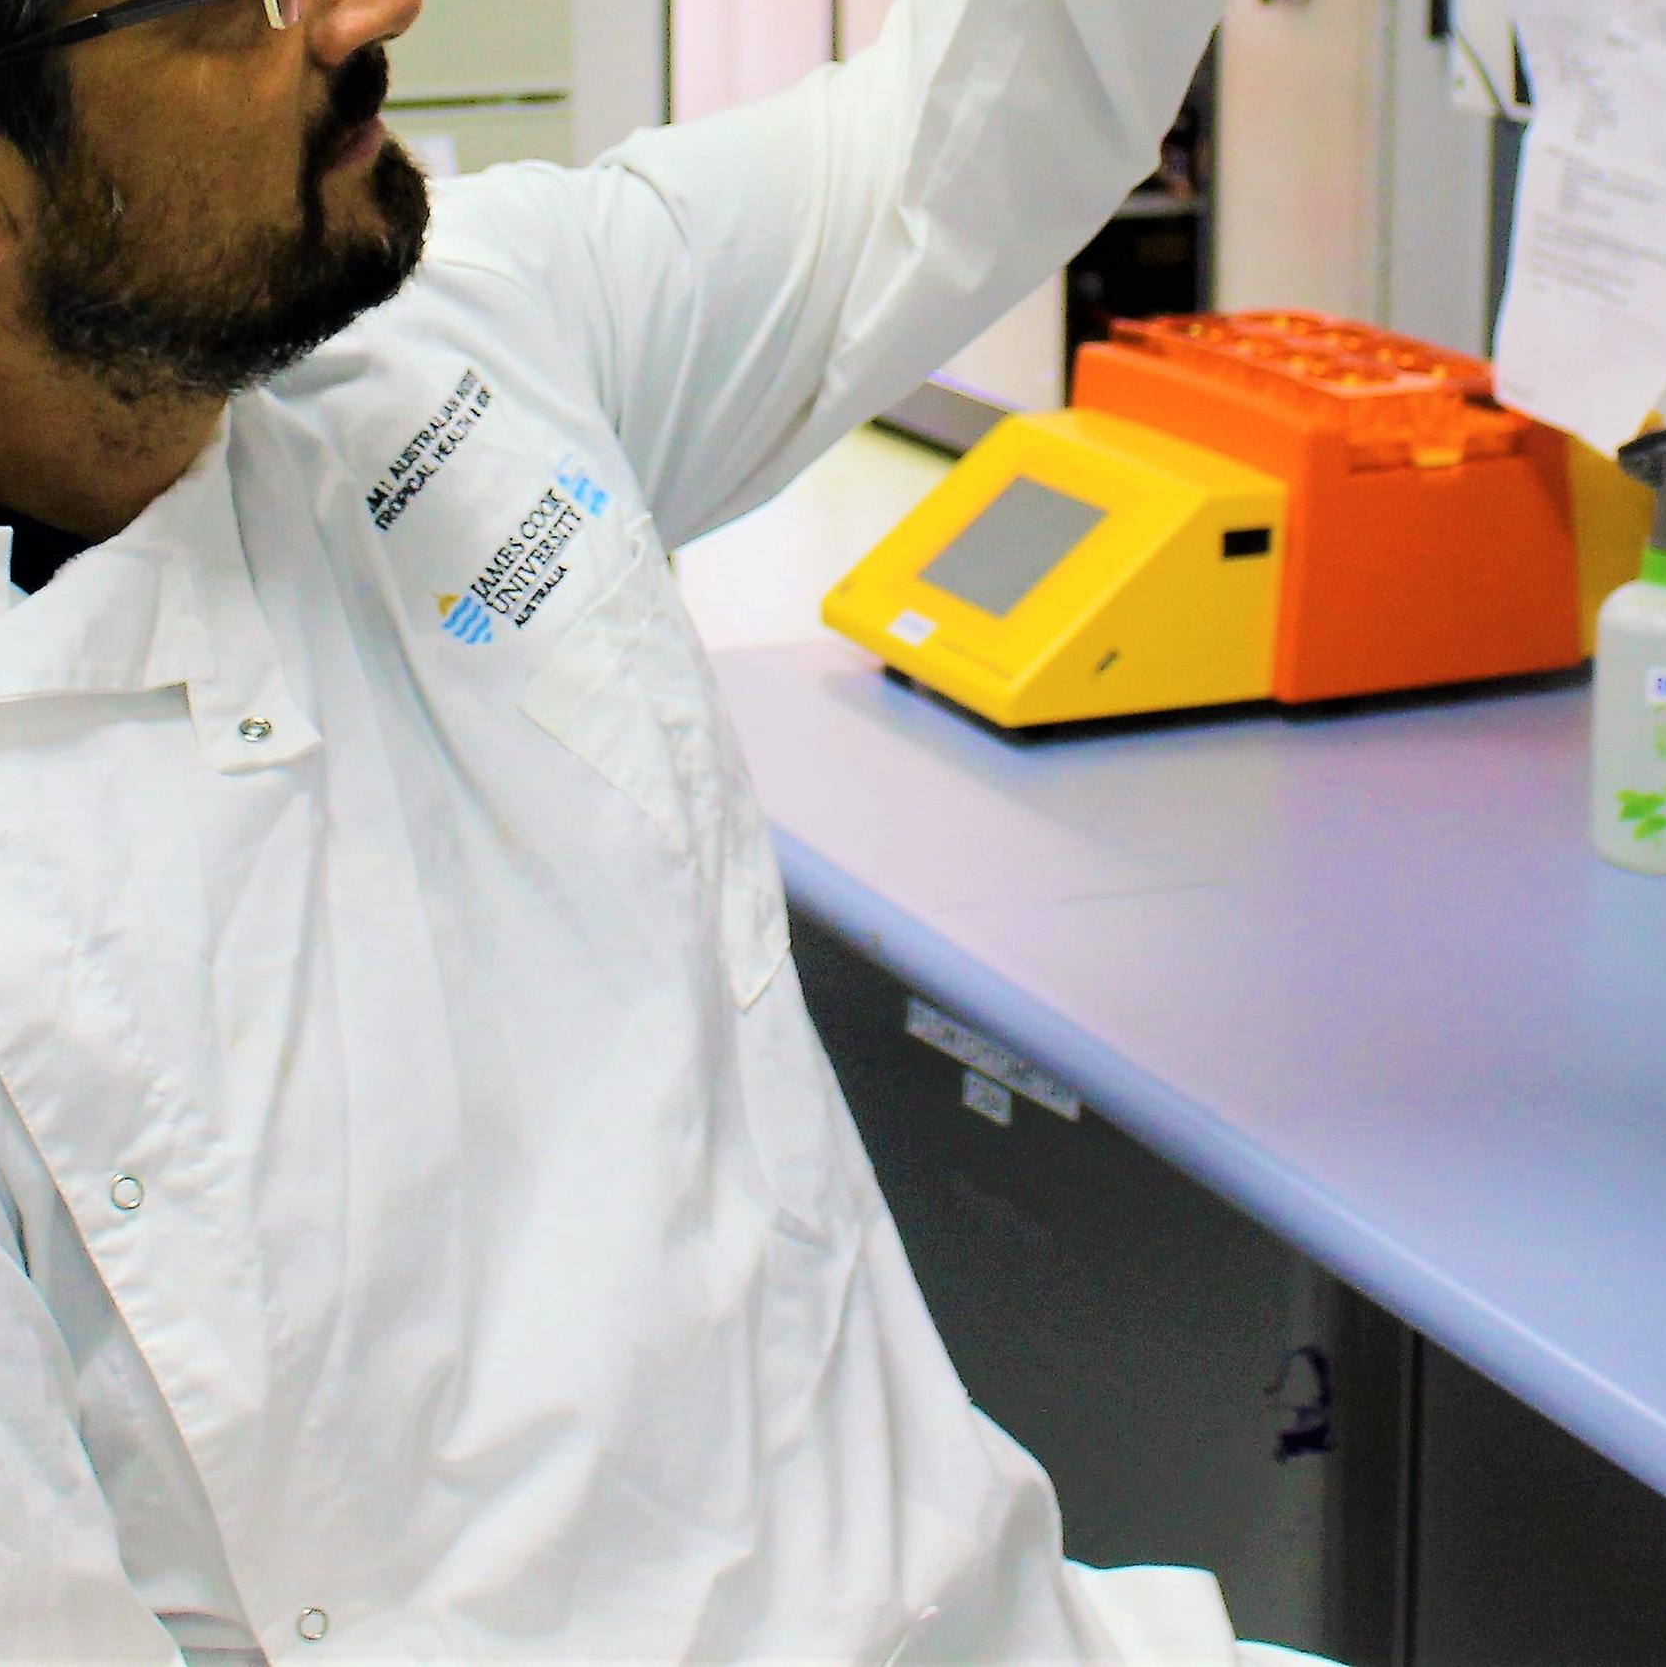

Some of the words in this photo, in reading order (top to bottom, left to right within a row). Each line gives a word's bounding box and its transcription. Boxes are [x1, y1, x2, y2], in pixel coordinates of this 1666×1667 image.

[375, 462, 439, 531] TROPICAL
[470, 536, 525, 600] JAMES
[520, 487, 566, 540] COOK
[486, 505, 582, 615] UNIVERSITY
[515, 564, 568, 628] AUSTRALIA
